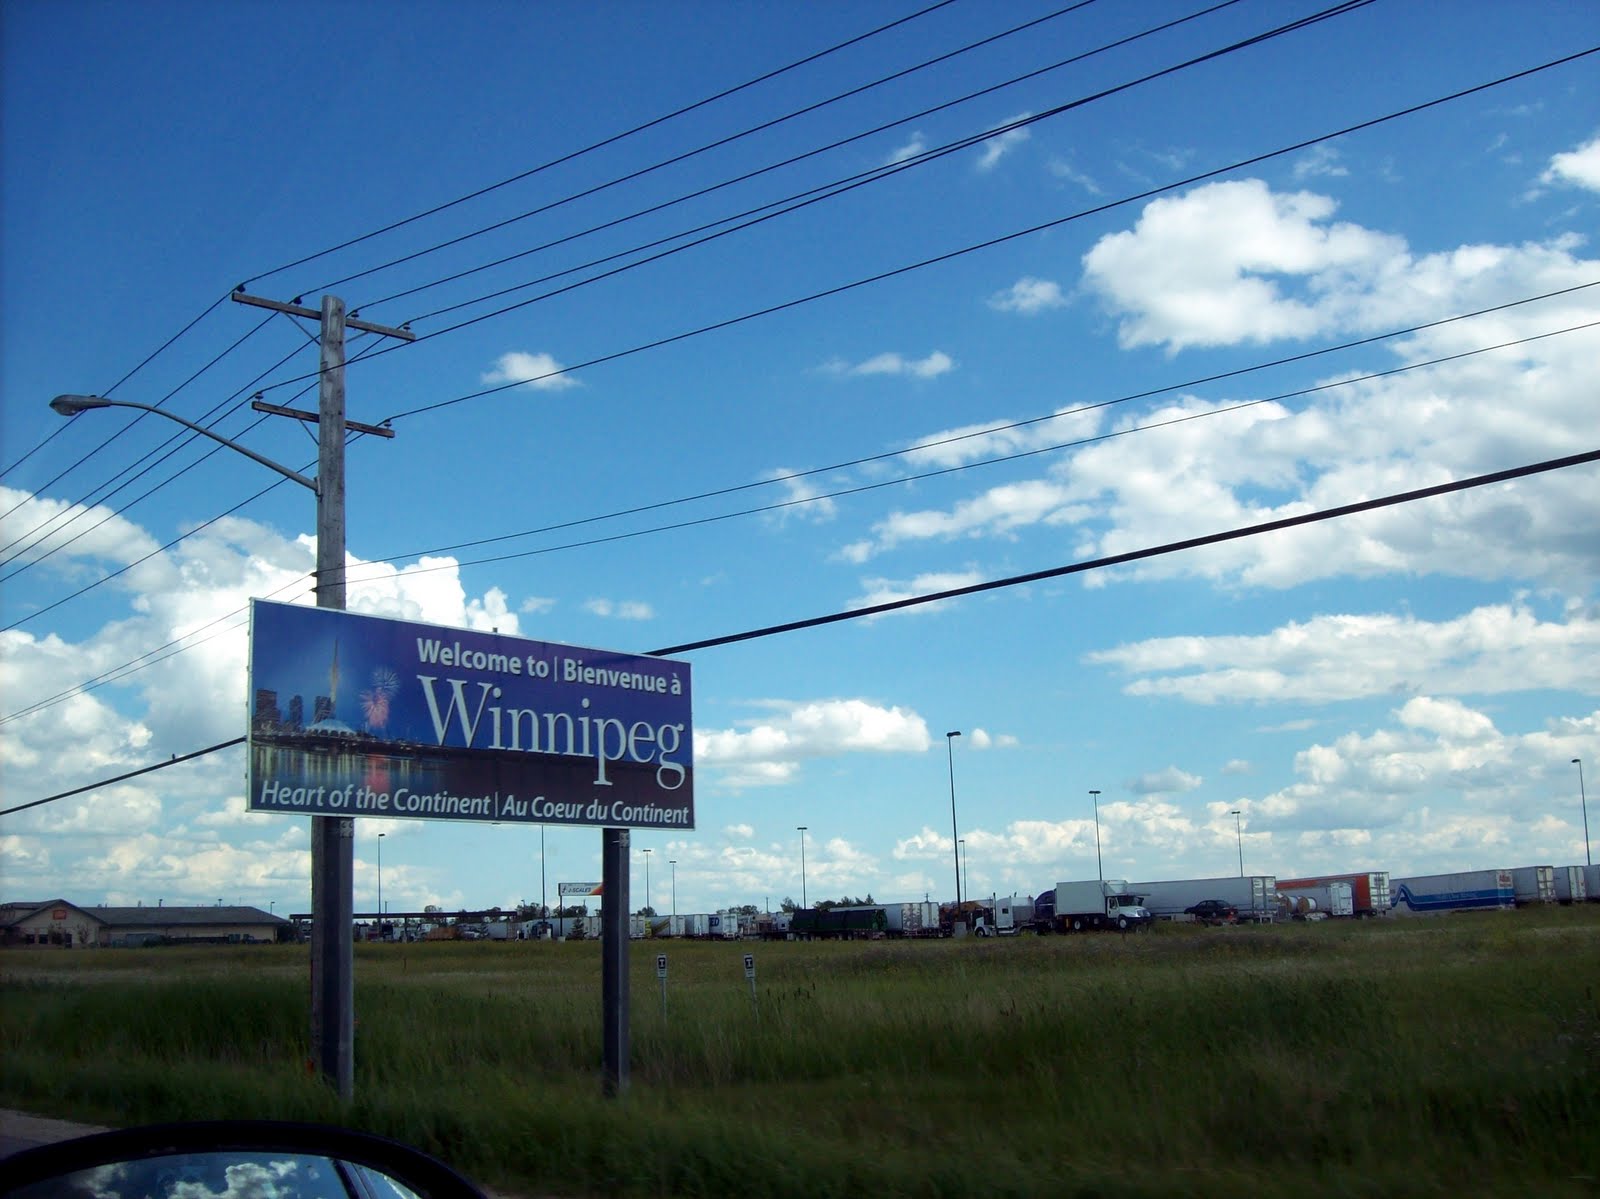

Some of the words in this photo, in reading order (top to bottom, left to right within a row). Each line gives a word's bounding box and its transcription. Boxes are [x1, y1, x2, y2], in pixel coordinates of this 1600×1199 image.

[416, 637, 522, 675] Welcome
[526, 655, 550, 678] to
[563, 658, 668, 694] Bienvenue
[670, 672, 682, 695] à
[416, 674, 686, 790] Winnipeg
[260, 780, 326, 807] Heart
[328, 784, 355, 808] of
[355, 785, 390, 810] the
[393, 788, 491, 815] Continent
[501, 794, 528, 817] Au
[531, 796, 584, 819] Coeur
[585, 799, 608, 820] du
[610, 801, 689, 824] Continent
